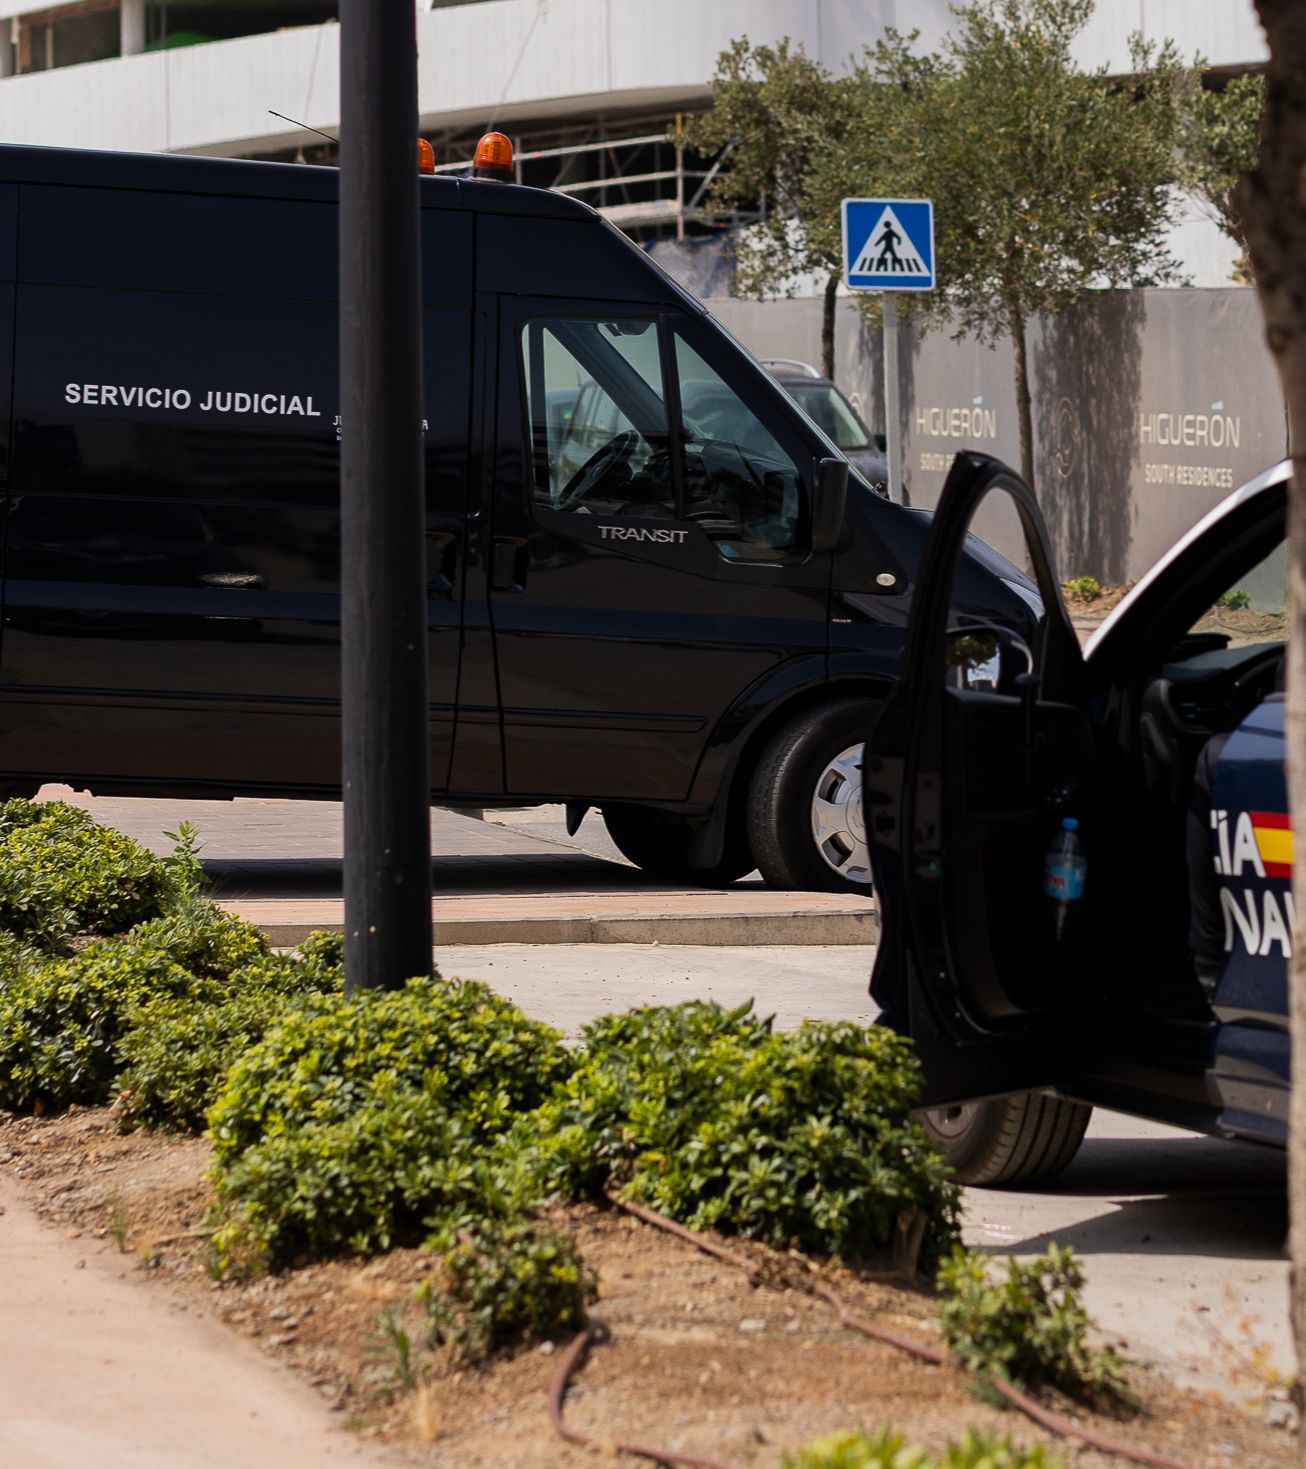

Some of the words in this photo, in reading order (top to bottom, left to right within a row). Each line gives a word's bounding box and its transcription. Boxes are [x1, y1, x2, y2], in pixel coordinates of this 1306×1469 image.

[64, 382, 192, 410] SERVICIO
[199, 390, 321, 416] JUDICIAL
[1145, 463, 1175, 485] SOUTH
[1176, 464, 1233, 489] RESIDENCES
[596, 525, 689, 543] TRANSIT
